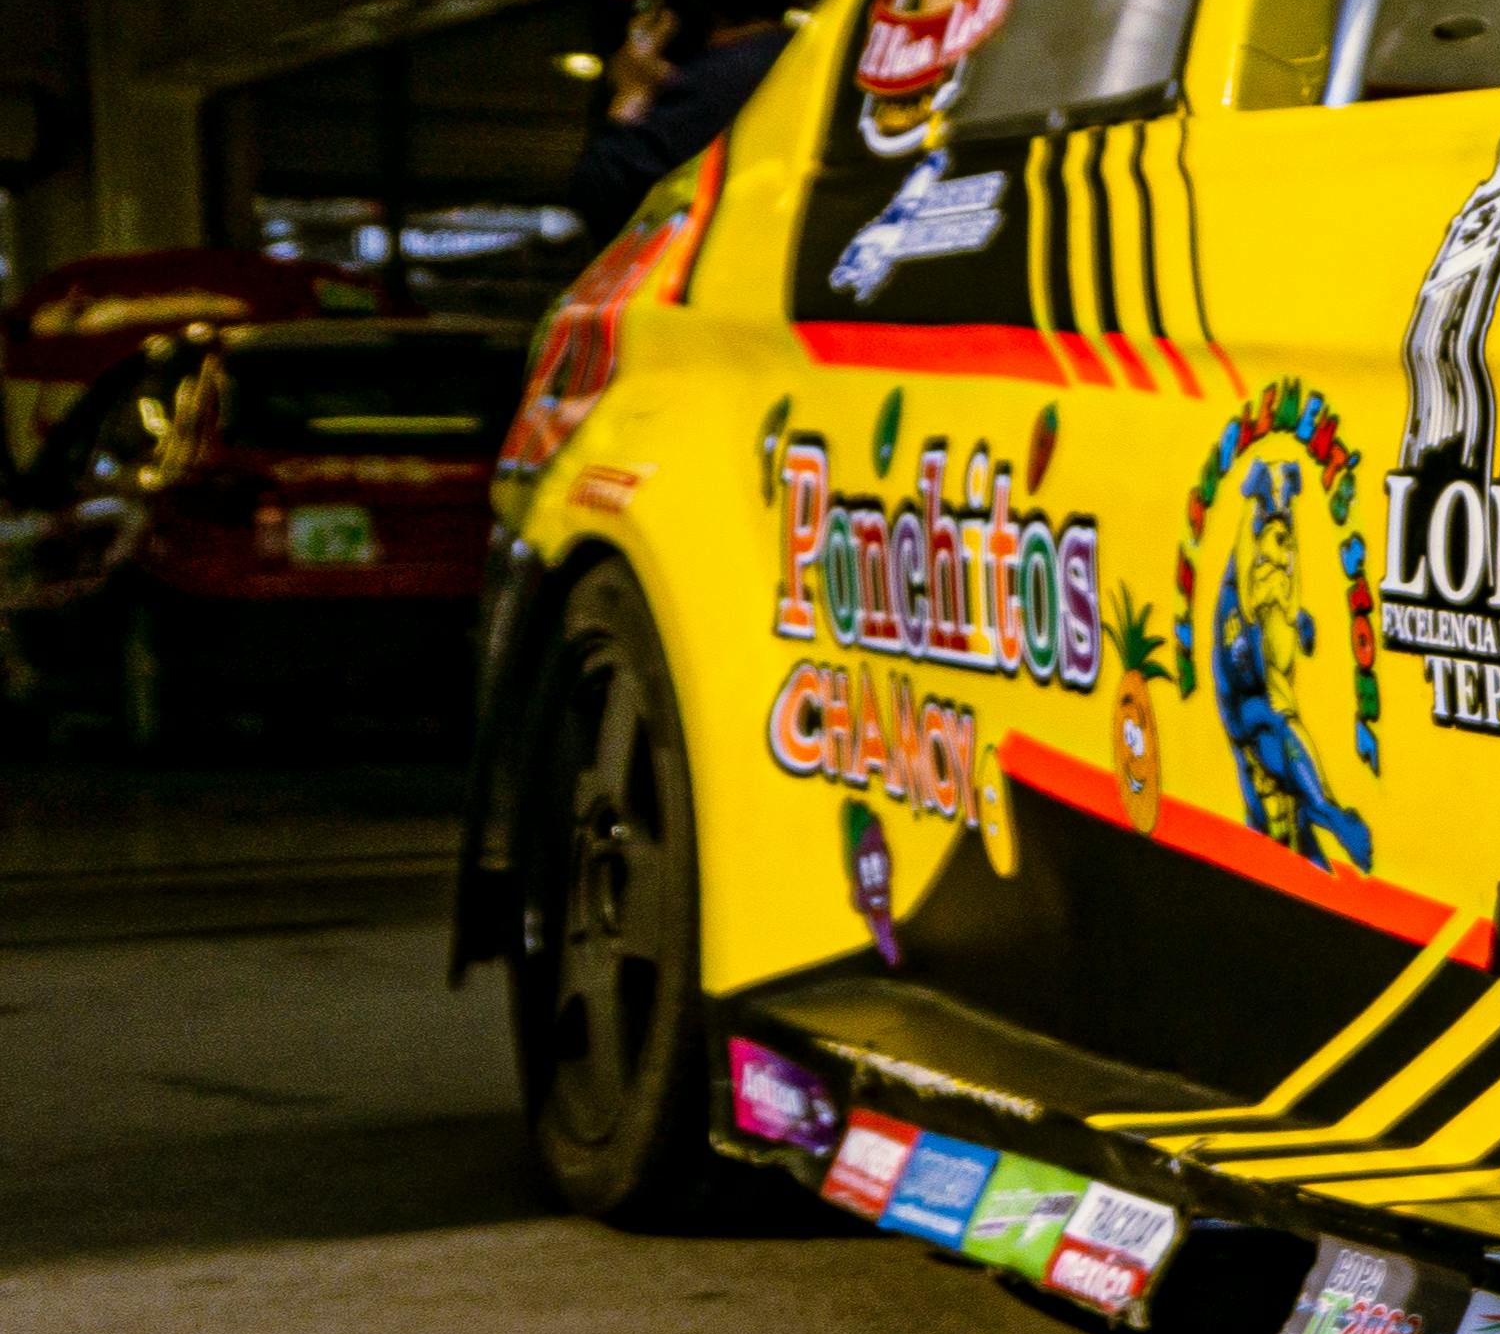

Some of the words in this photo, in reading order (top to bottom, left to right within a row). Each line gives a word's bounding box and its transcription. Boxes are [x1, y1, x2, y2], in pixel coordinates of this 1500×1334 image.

[776, 440, 1099, 691] Ponchitos
[1381, 603, 1497, 655] EXCELENCIA
[768, 664, 979, 828] CHAMOY
